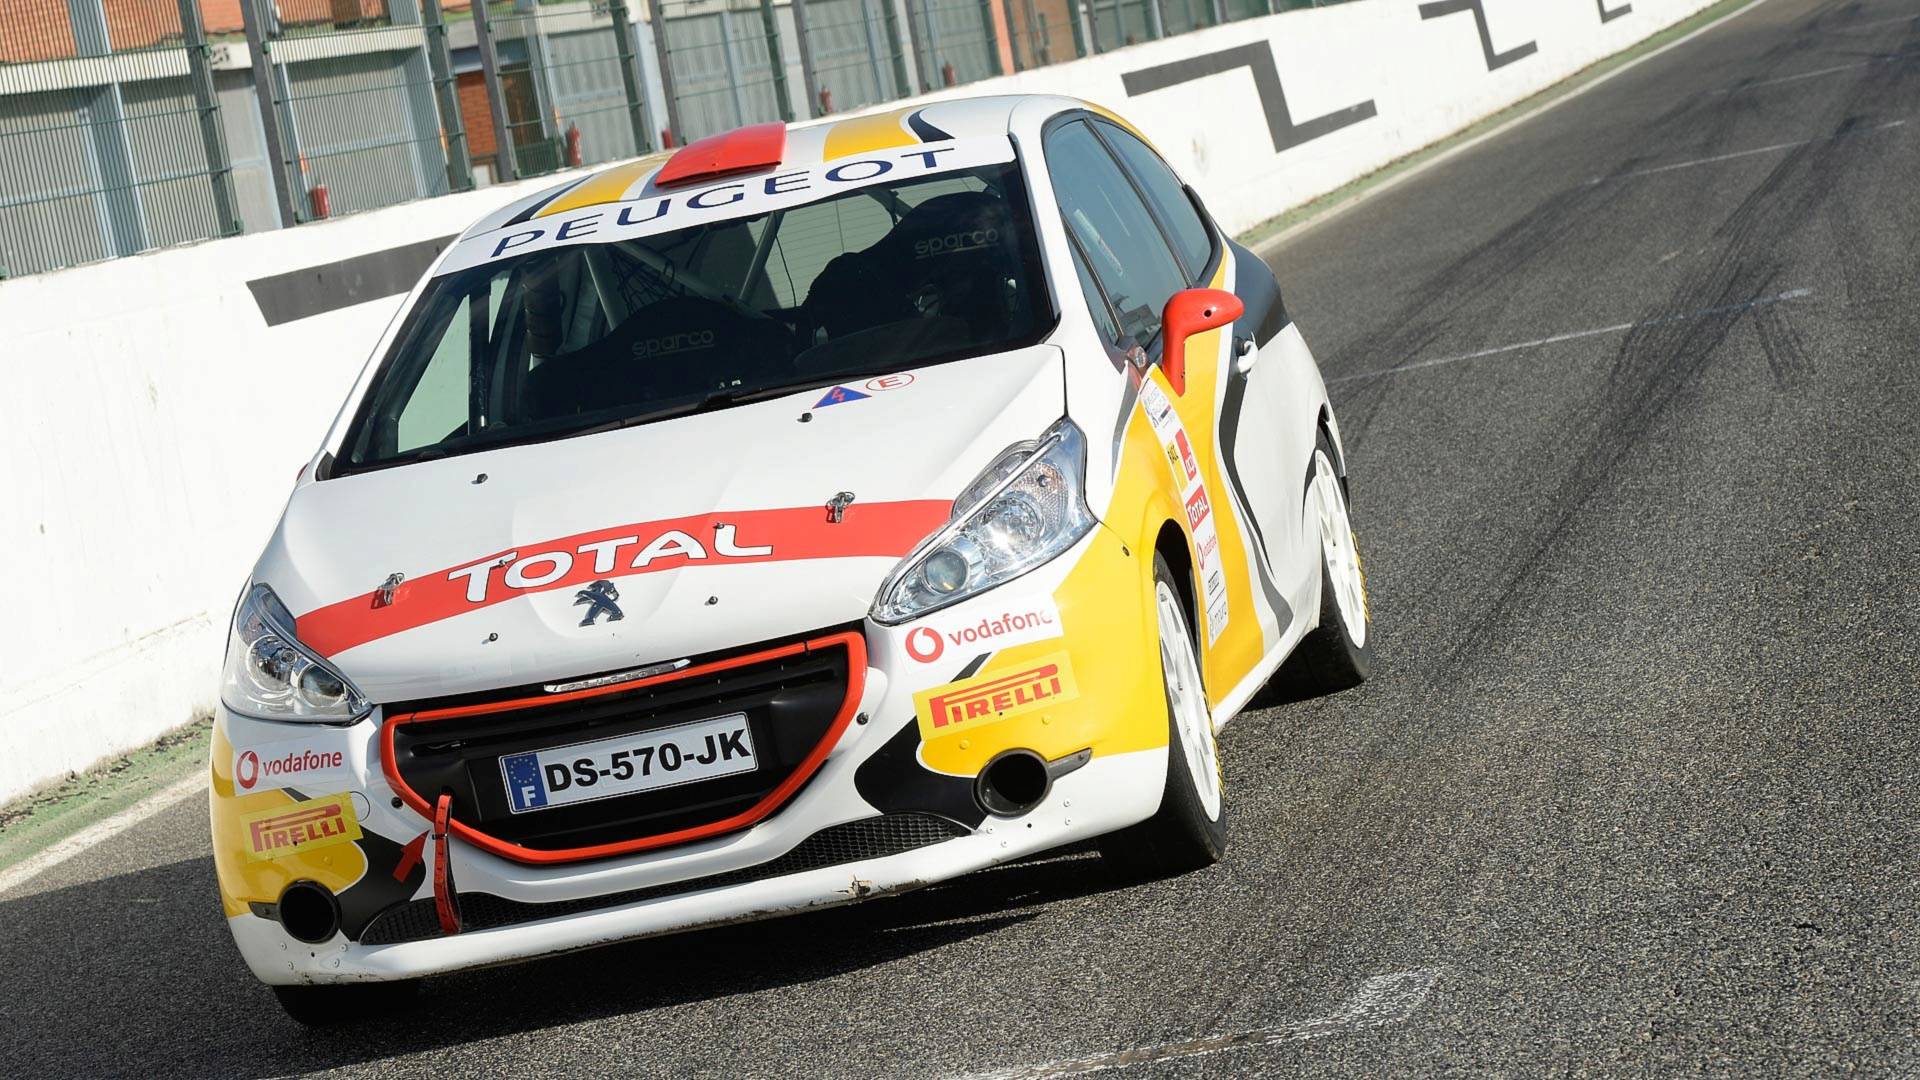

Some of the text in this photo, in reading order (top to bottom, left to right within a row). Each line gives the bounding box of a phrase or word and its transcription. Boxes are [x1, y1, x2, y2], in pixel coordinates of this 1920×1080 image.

[491, 147, 955, 258] PEUGEOT
[914, 228, 998, 258] sparco
[632, 330, 714, 360] sparco
[879, 376, 903, 388] E
[1187, 496, 1208, 525] TOTAL
[447, 524, 774, 603] TOTAL
[929, 663, 1062, 729] PIRELLI
[263, 750, 343, 777] vodafone
[544, 729, 752, 793] DS-570-JK
[521, 785, 536, 807] F
[249, 803, 347, 853] PIRELLI
